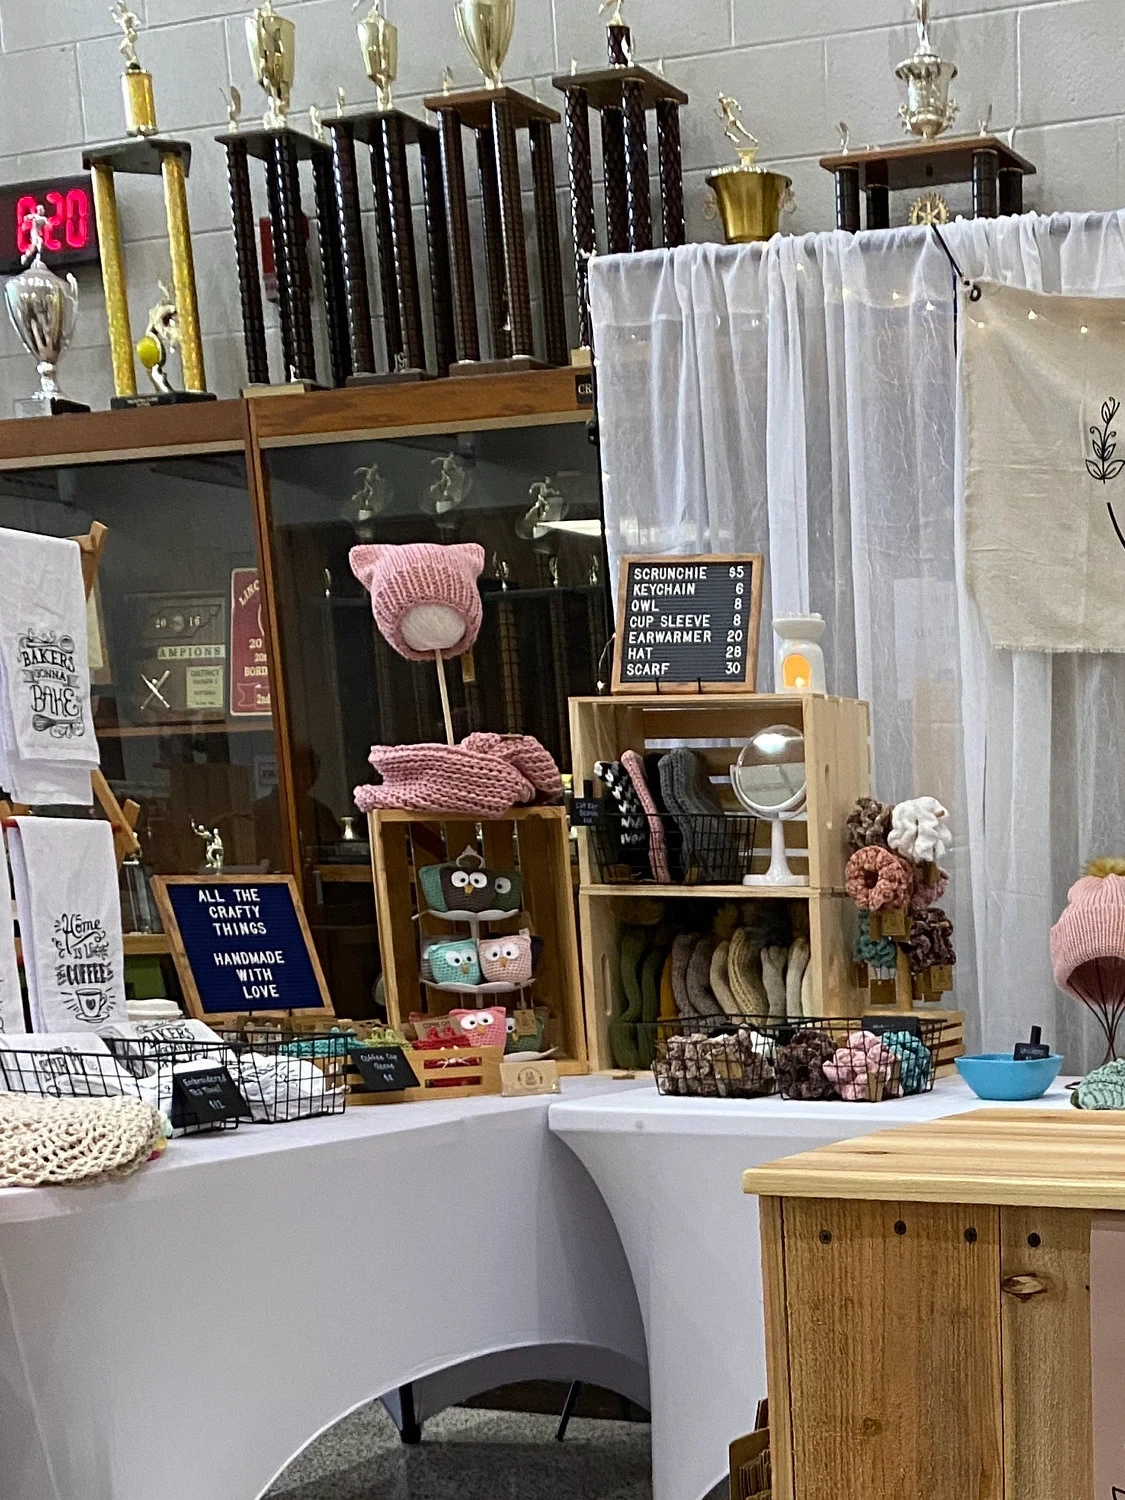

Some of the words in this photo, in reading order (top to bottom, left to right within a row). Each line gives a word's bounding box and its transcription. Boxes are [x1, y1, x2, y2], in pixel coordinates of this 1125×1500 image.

[634, 567, 707, 580] SCRUNCHIE
[728, 566, 744, 578] $5
[633, 583, 695, 596] KEYCHAIN
[735, 583, 743, 595] 6
[631, 599, 659, 611] OWL
[734, 597, 742, 609] 8
[630, 615, 654, 627] CUP
[660, 614, 711, 627] SLEEVE
[733, 614, 741, 626] 8
[629, 630, 711, 643] EARWARMER
[727, 630, 743, 642] 20
[628, 647, 653, 659] HAT
[726, 646, 741, 658] 28
[21, 649, 75, 673] BAKERS
[626, 663, 670, 675] SCARF
[725, 662, 741, 674] 30
[30, 684, 80, 717] BAKE
[199, 889, 225, 903] ALL
[233, 888, 260, 901] THE
[209, 905, 260, 919] CRAFTY
[212, 922, 267, 936] THINGS
[213, 951, 285, 966] HANDMADE
[236, 968, 272, 982] WITH
[243, 984, 279, 999] LOVE
